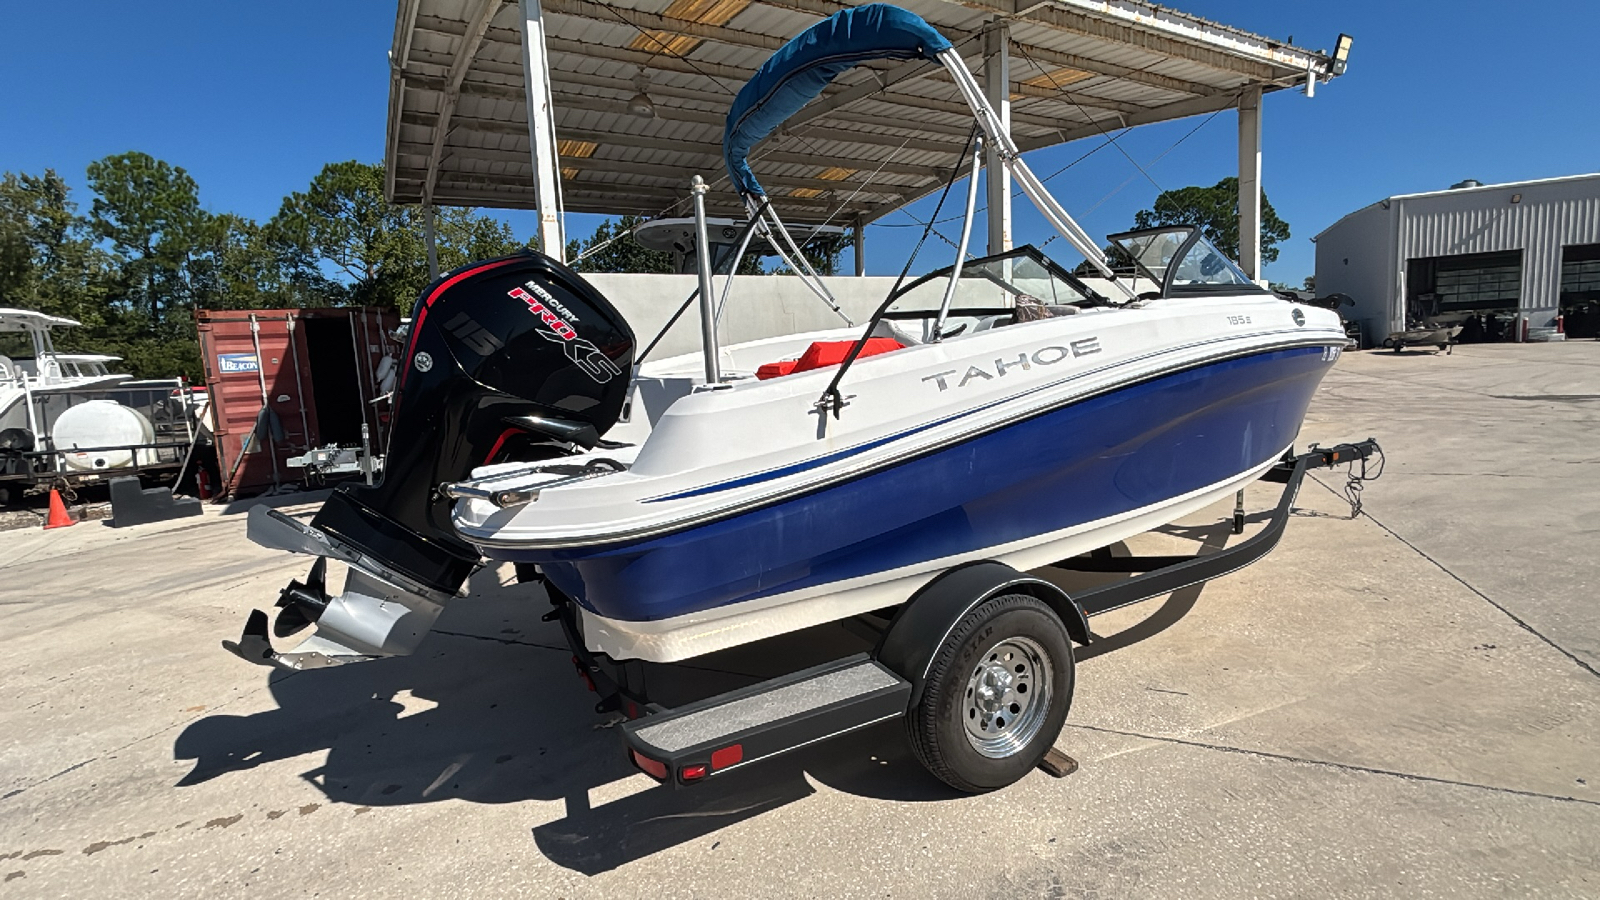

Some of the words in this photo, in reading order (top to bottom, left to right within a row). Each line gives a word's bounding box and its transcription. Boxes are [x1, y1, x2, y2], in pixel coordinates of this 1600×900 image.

[507, 287, 577, 341] PRO
[525, 280, 580, 322] MERCURY
[442, 311, 505, 356] 115
[534, 318, 622, 384] XS
[921, 336, 1102, 392] TAHOE
